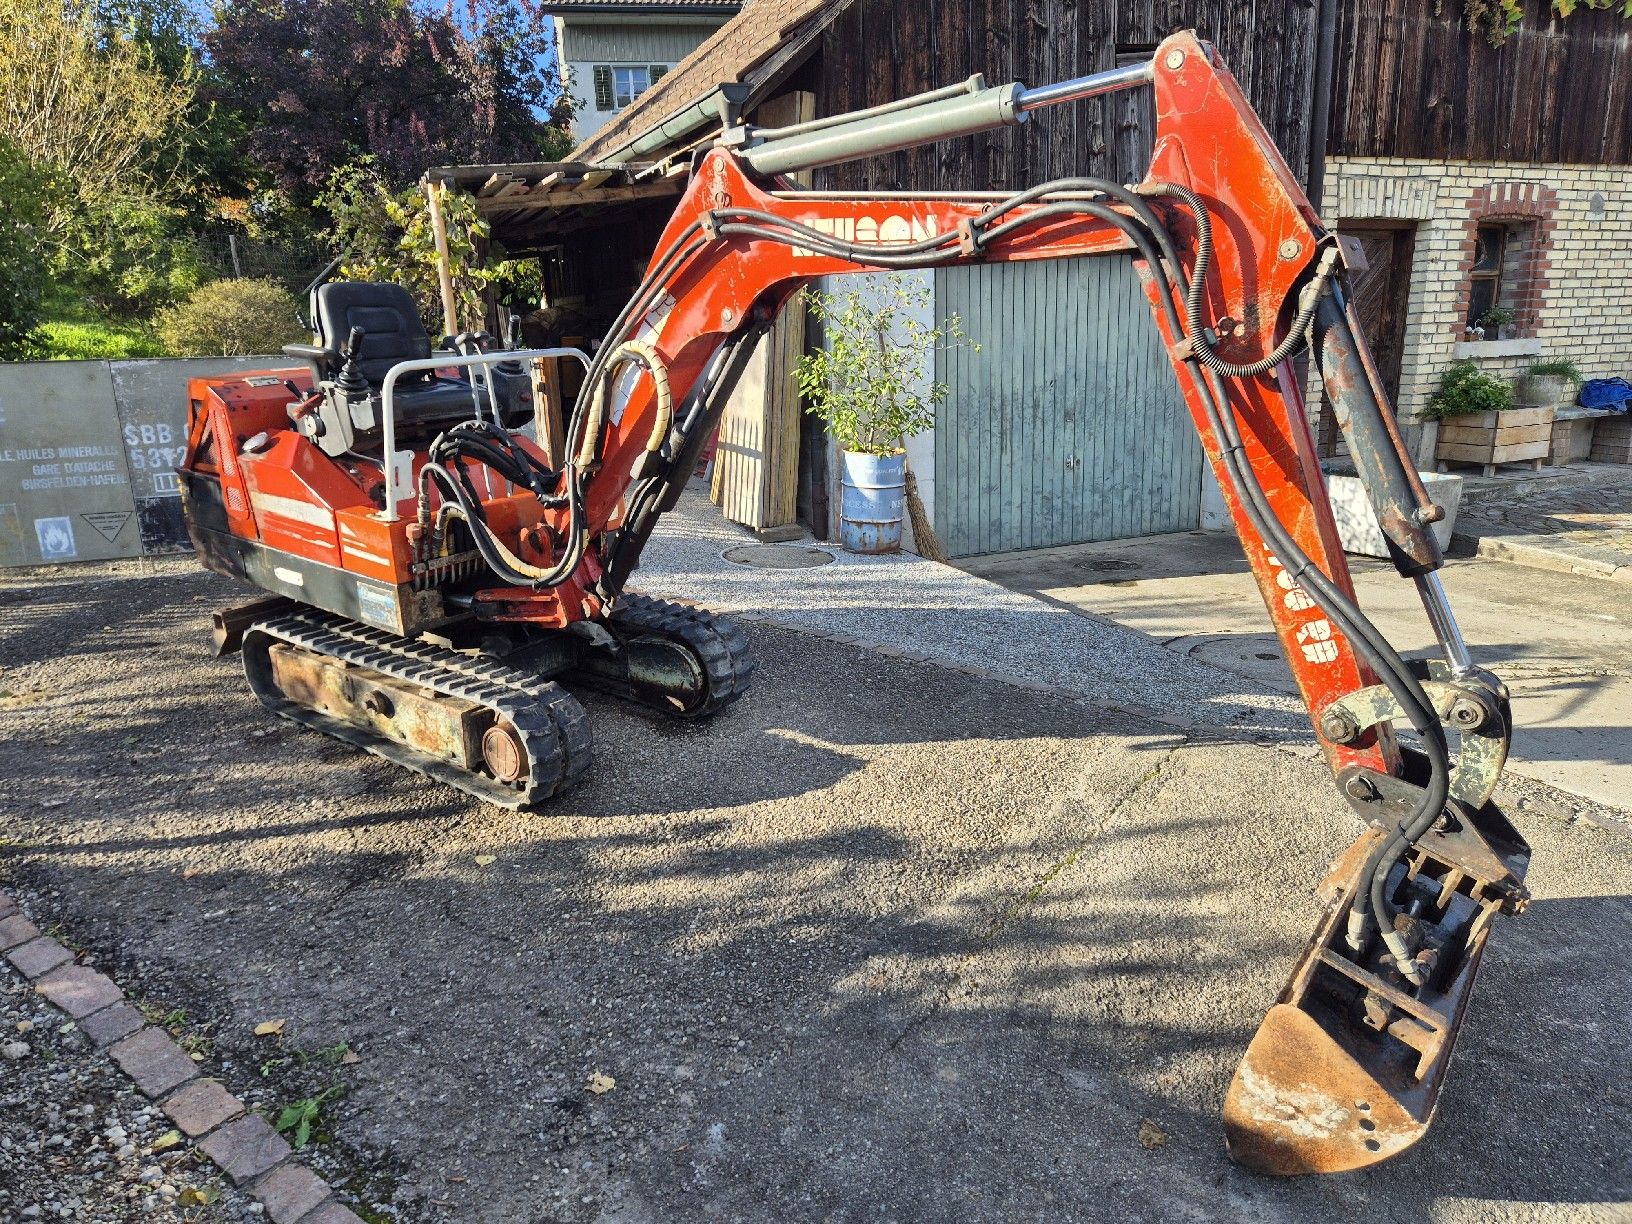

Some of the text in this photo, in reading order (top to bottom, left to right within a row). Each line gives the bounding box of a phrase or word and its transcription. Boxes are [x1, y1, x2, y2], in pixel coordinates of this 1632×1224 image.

[125, 423, 171, 445] SBB
[16, 447, 55, 460] HUILES
[32, 464, 61, 475] GARE
